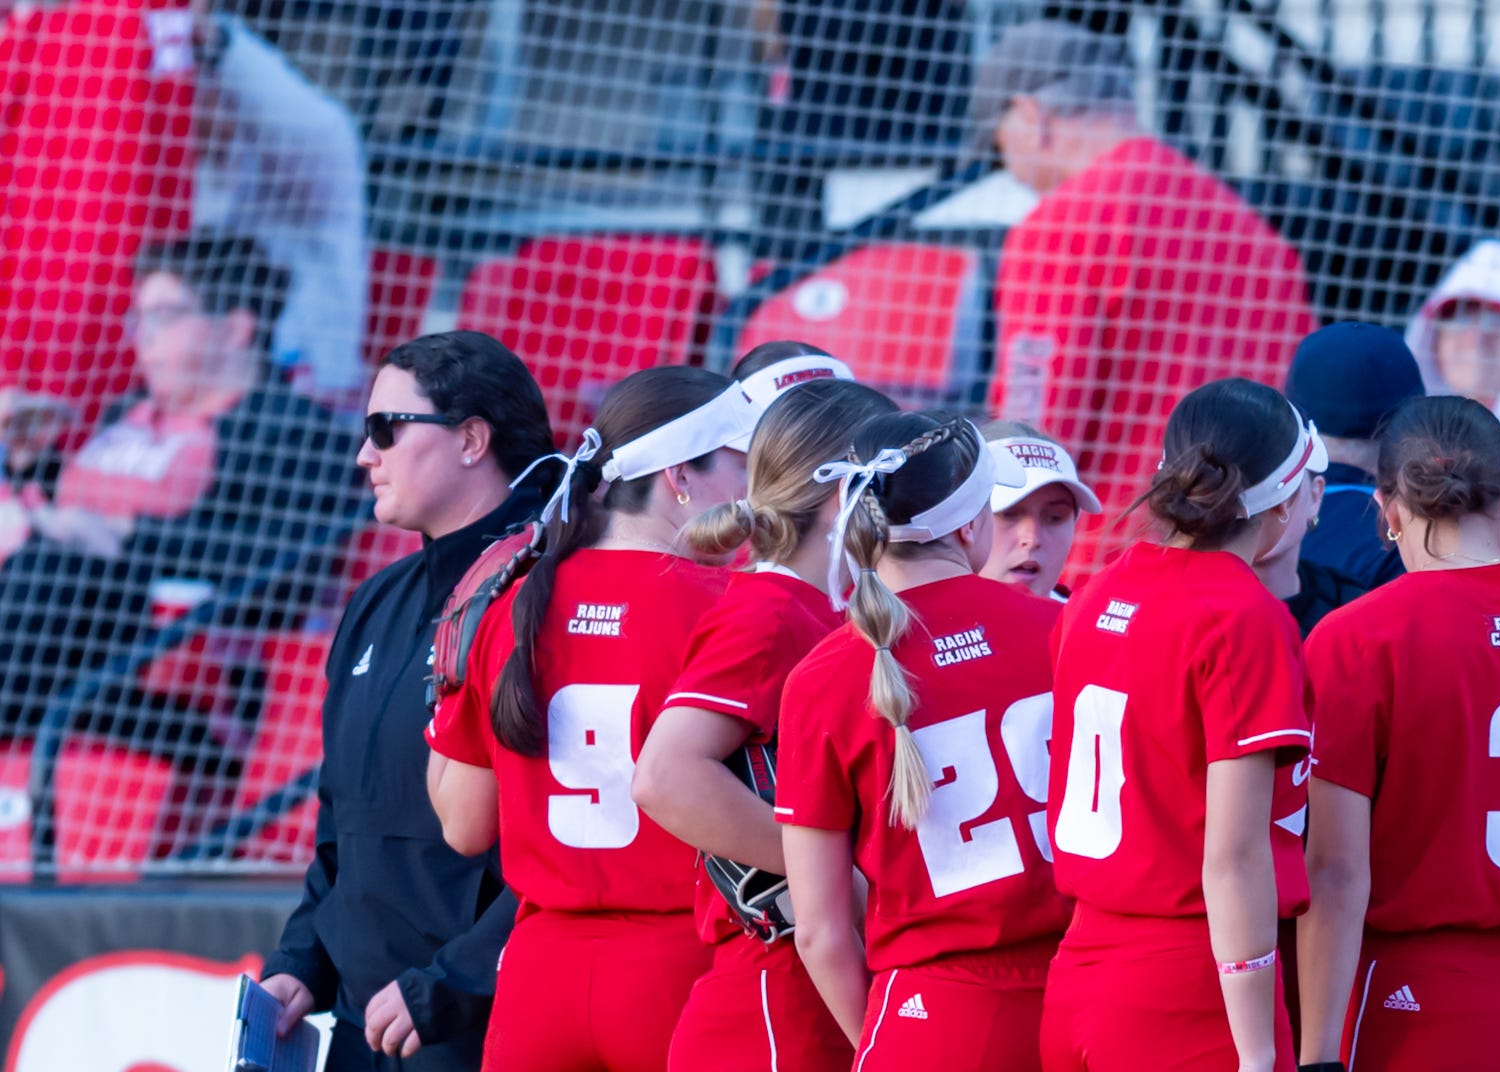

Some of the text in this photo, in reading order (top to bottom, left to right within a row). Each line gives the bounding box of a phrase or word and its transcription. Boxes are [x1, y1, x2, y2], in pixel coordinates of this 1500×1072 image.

[577, 604, 621, 620] RAGIN
[1106, 600, 1136, 618] RAGIN
[568, 619, 621, 636] CAJUNS
[1096, 614, 1129, 633] CAJUNS
[933, 628, 983, 652] RAGIN
[934, 641, 992, 667] CAJUNS
[547, 683, 640, 849] 9
[1055, 683, 1128, 859] 0
[898, 1008, 928, 1019] adidas
[1384, 1000, 1420, 1011] adidas
